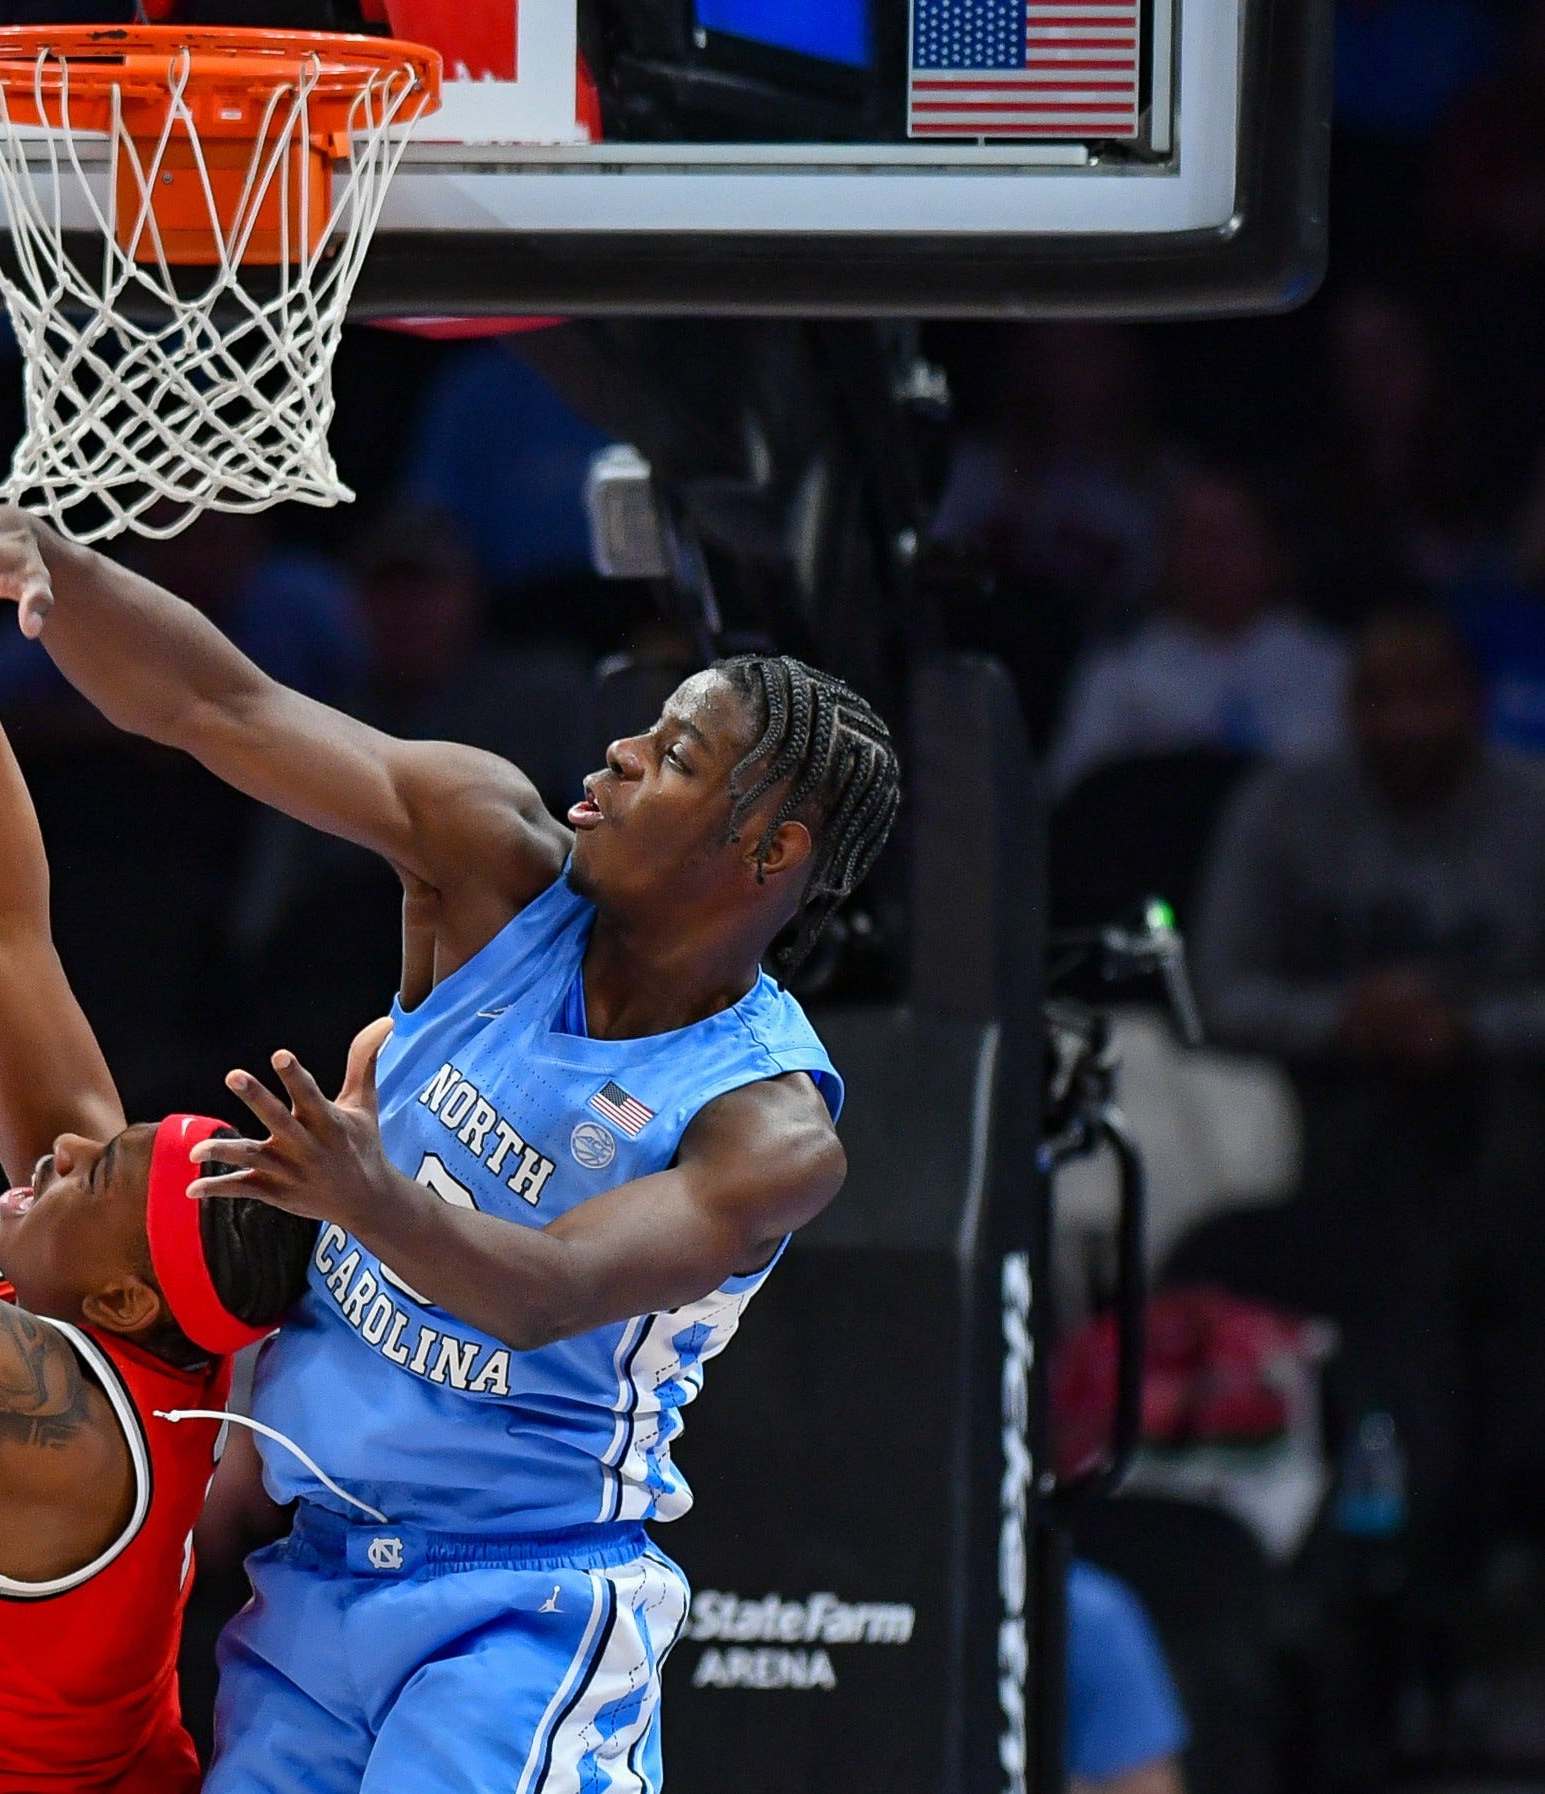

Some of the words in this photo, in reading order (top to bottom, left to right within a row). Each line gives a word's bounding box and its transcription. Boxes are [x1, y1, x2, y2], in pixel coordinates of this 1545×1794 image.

[417, 1061, 556, 1207] NORTH
[313, 1222, 513, 1397] CAROLINA
[691, 1645, 838, 1692] ARENA
